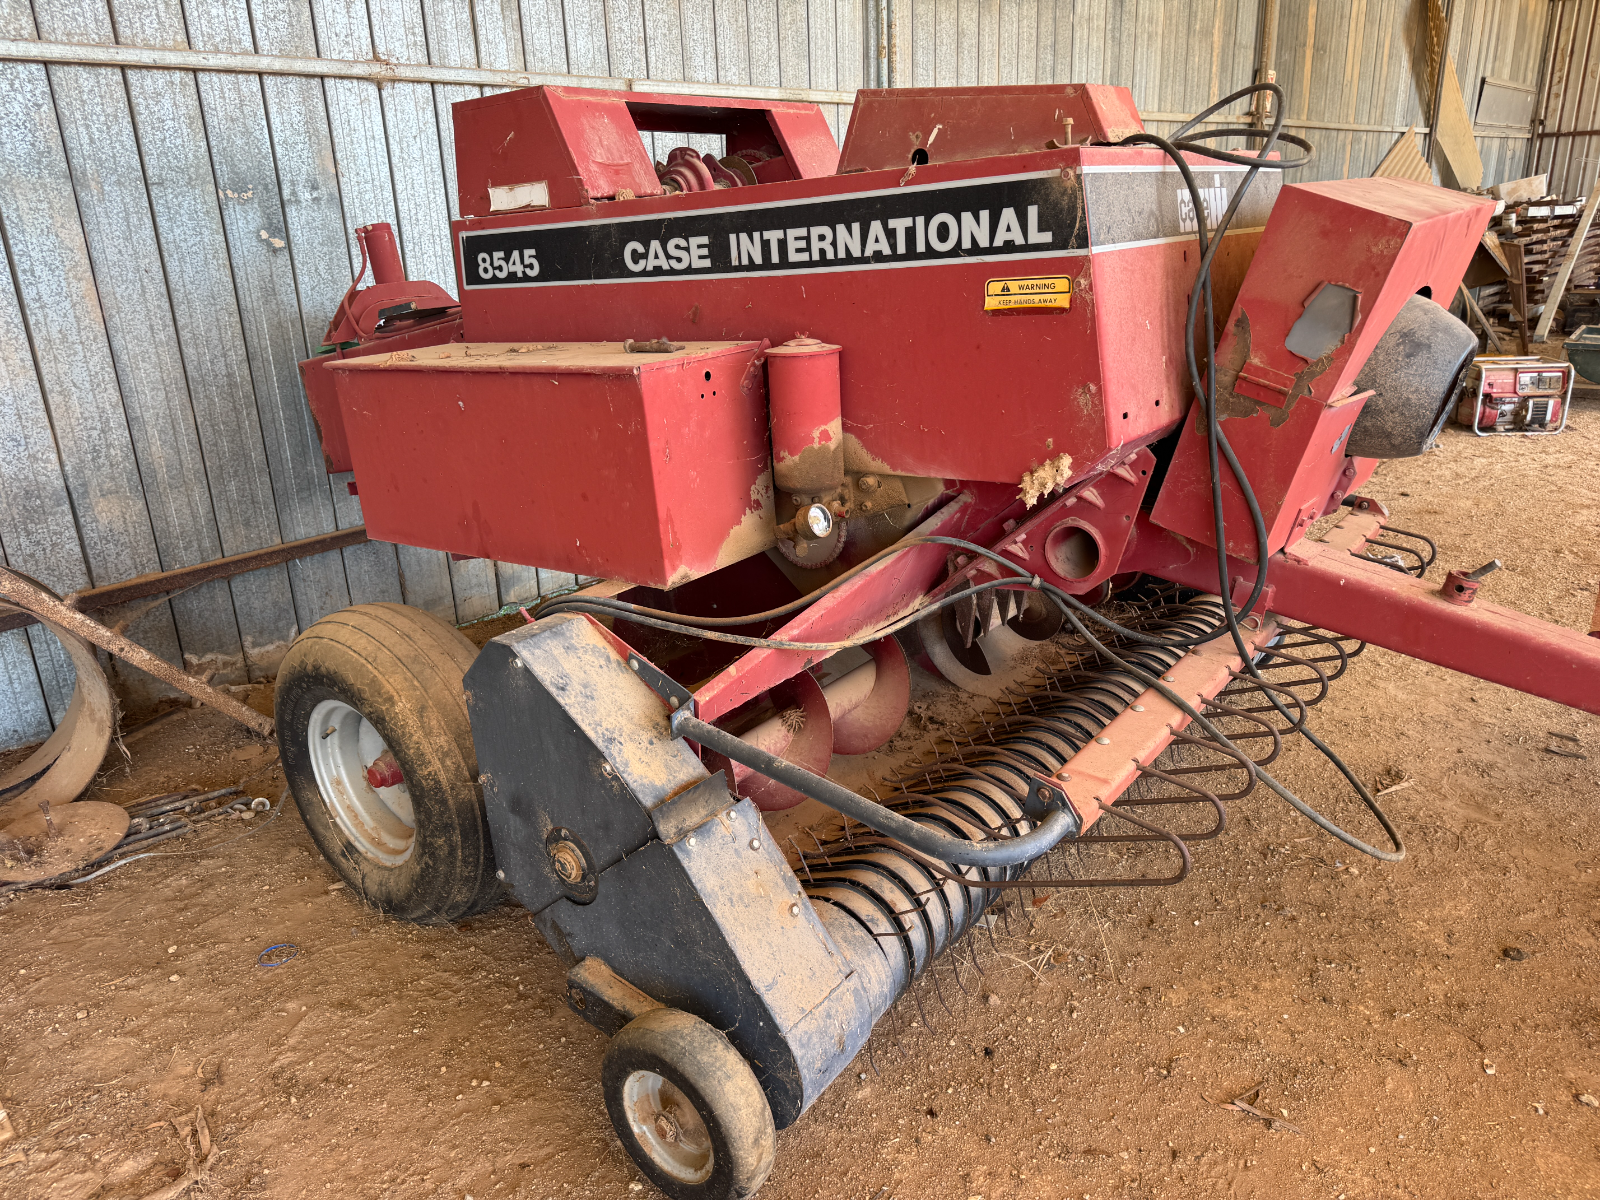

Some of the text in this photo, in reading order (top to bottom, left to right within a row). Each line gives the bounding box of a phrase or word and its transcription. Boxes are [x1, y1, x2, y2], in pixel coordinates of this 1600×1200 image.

[477, 205, 1053, 280] 8545 CASE INTERNATIONAL
[1018, 282, 1056, 291] WARNING
